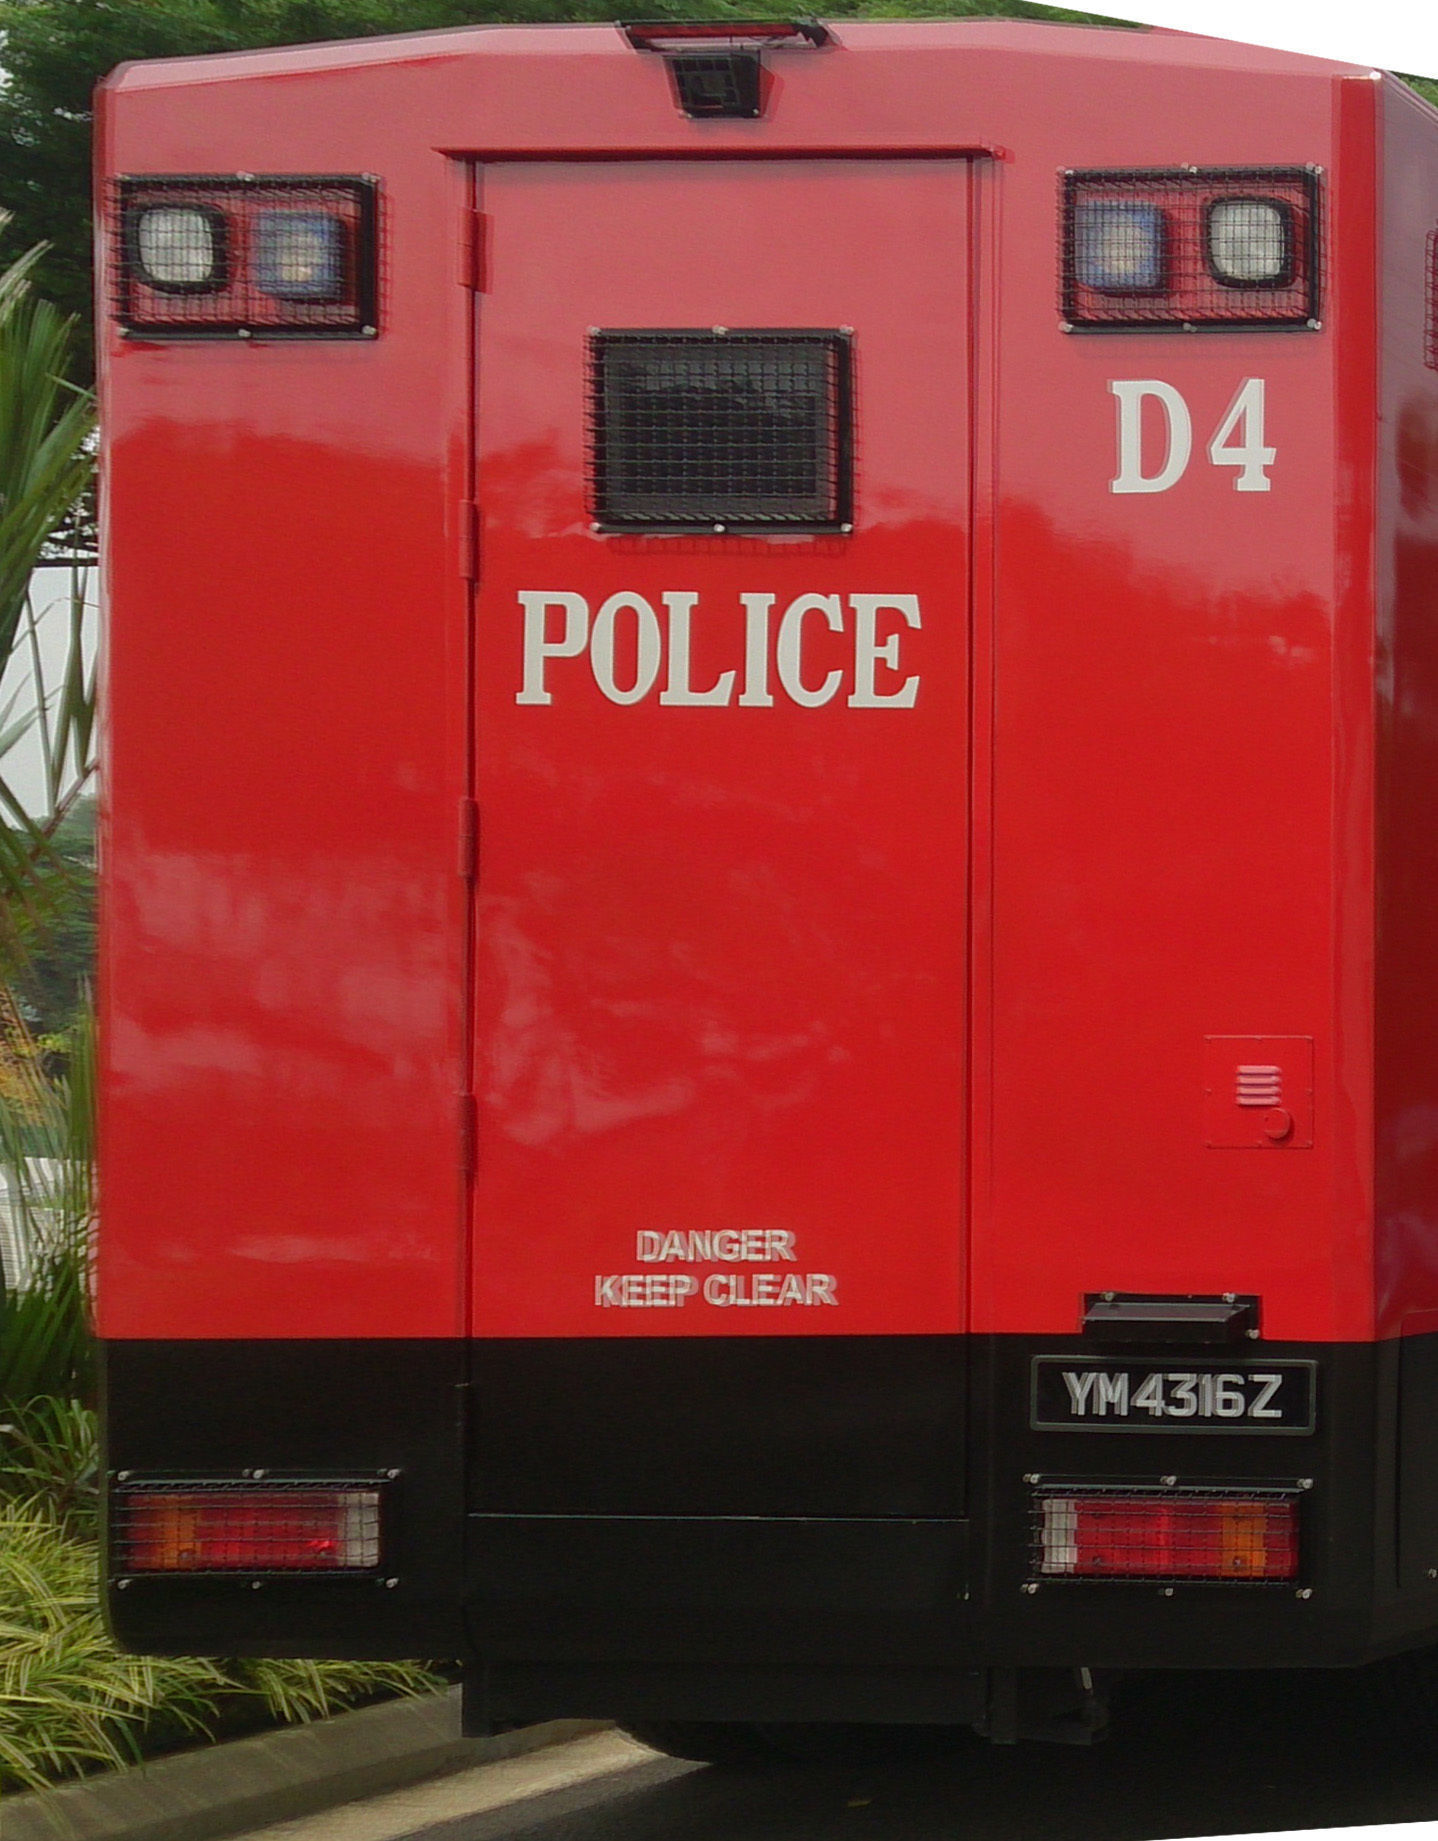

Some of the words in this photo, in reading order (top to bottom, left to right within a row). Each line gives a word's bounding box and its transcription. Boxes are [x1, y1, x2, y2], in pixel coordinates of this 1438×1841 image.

[514, 589, 923, 709] POLICE
[635, 1229, 797, 1262] DANGER
[594, 1273, 699, 1308] KEEP
[703, 1273, 839, 1307] CLEAR
